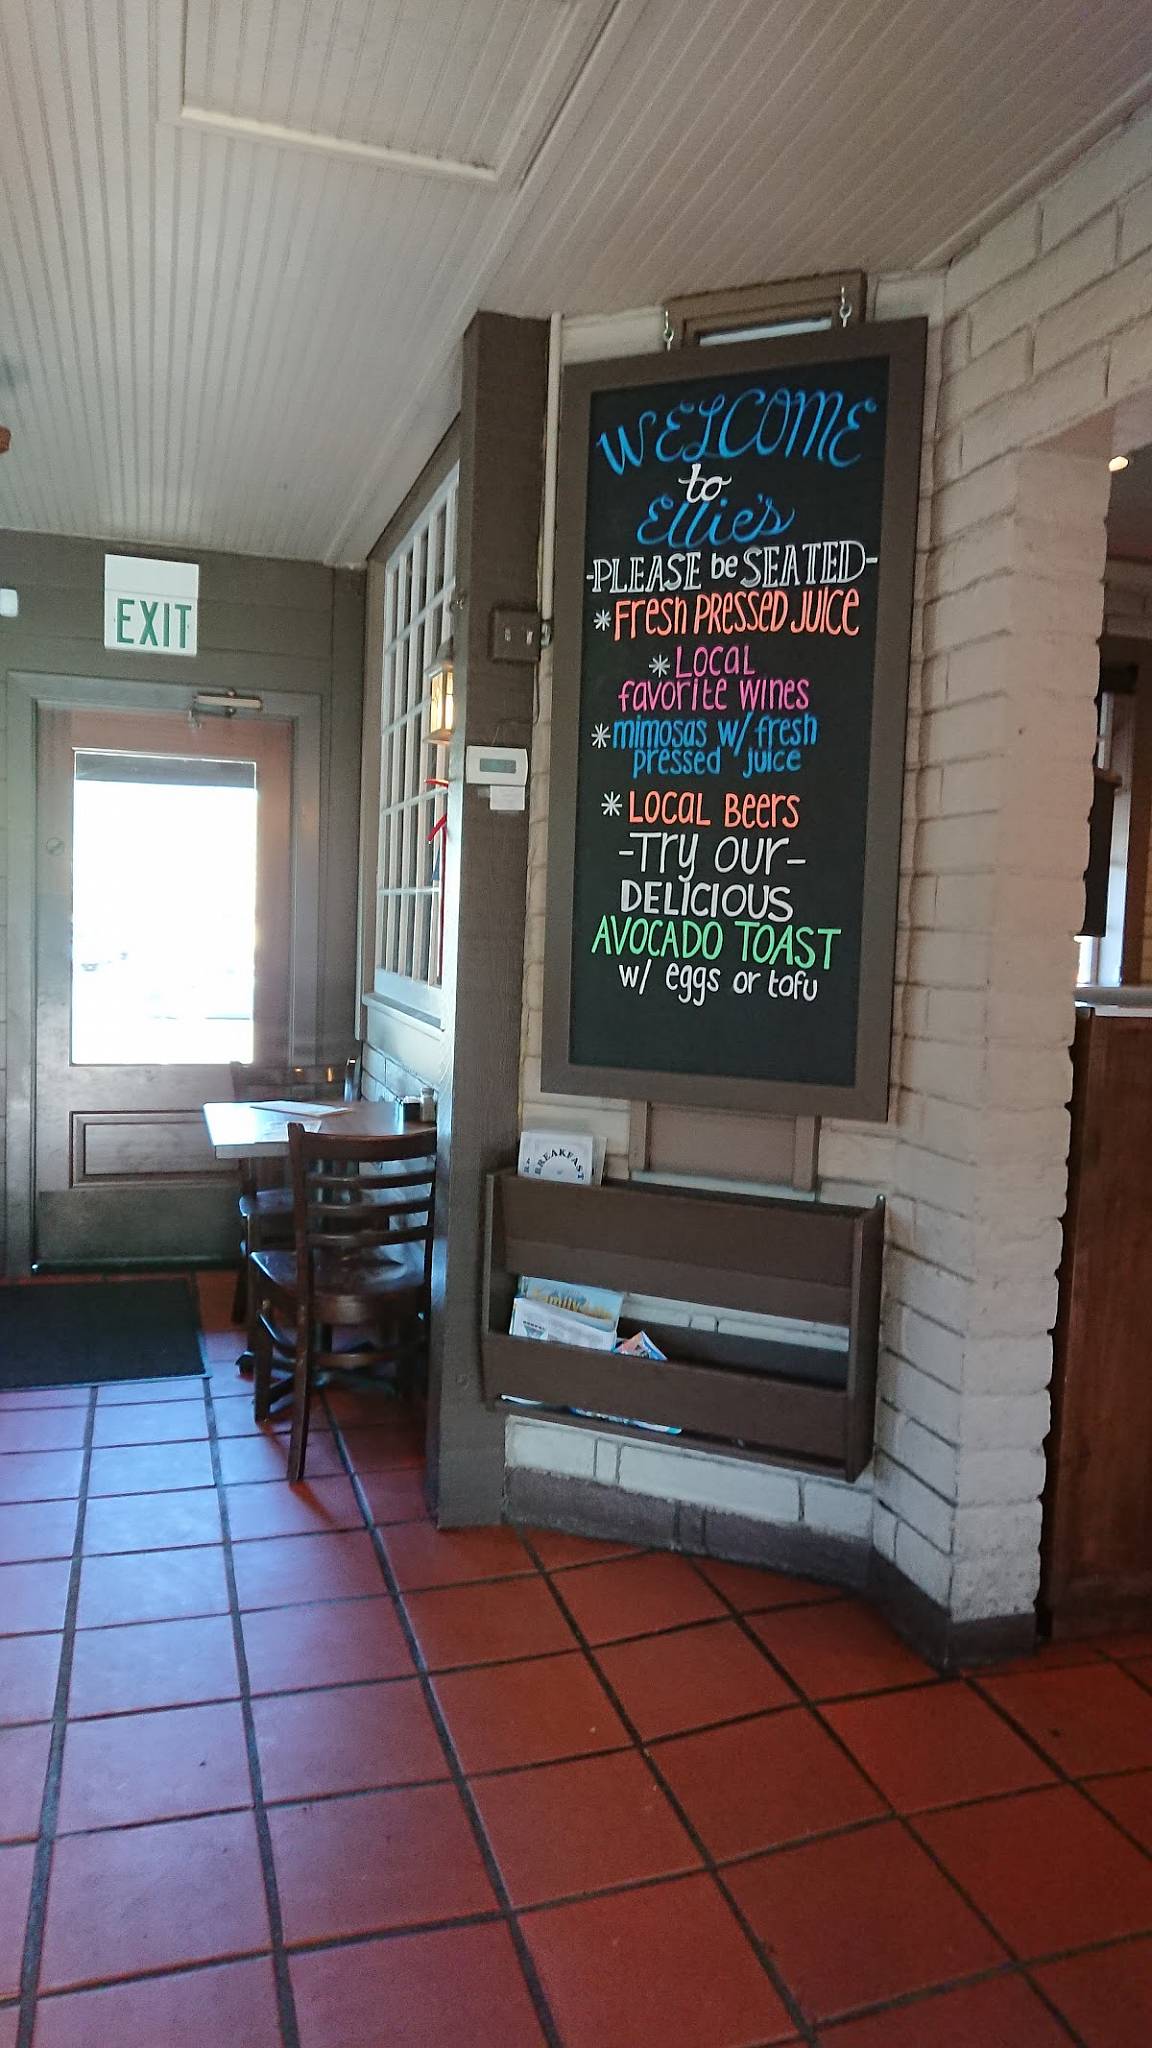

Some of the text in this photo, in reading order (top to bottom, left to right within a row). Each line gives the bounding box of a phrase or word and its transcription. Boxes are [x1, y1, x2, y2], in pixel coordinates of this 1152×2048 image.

[596, 387, 878, 476] WELCOME
[678, 463, 732, 503] to
[636, 492, 796, 549] Ellie's
[710, 552, 738, 579] be
[117, 598, 192, 648] EXIT
[613, 596, 687, 641] Fresh
[618, 678, 810, 713] favorite wines
[612, 711, 818, 757] mimosas w/ fresh
[632, 747, 801, 779] pressed juice
[724, 793, 801, 829] Beers
[620, 879, 794, 923] DELICIOUS
[591, 914, 842, 970] AVOCADO TOAST
[619, 958, 819, 1007] w/ eggs or tofu
[535, 1148, 585, 1180] BREAKFAST
